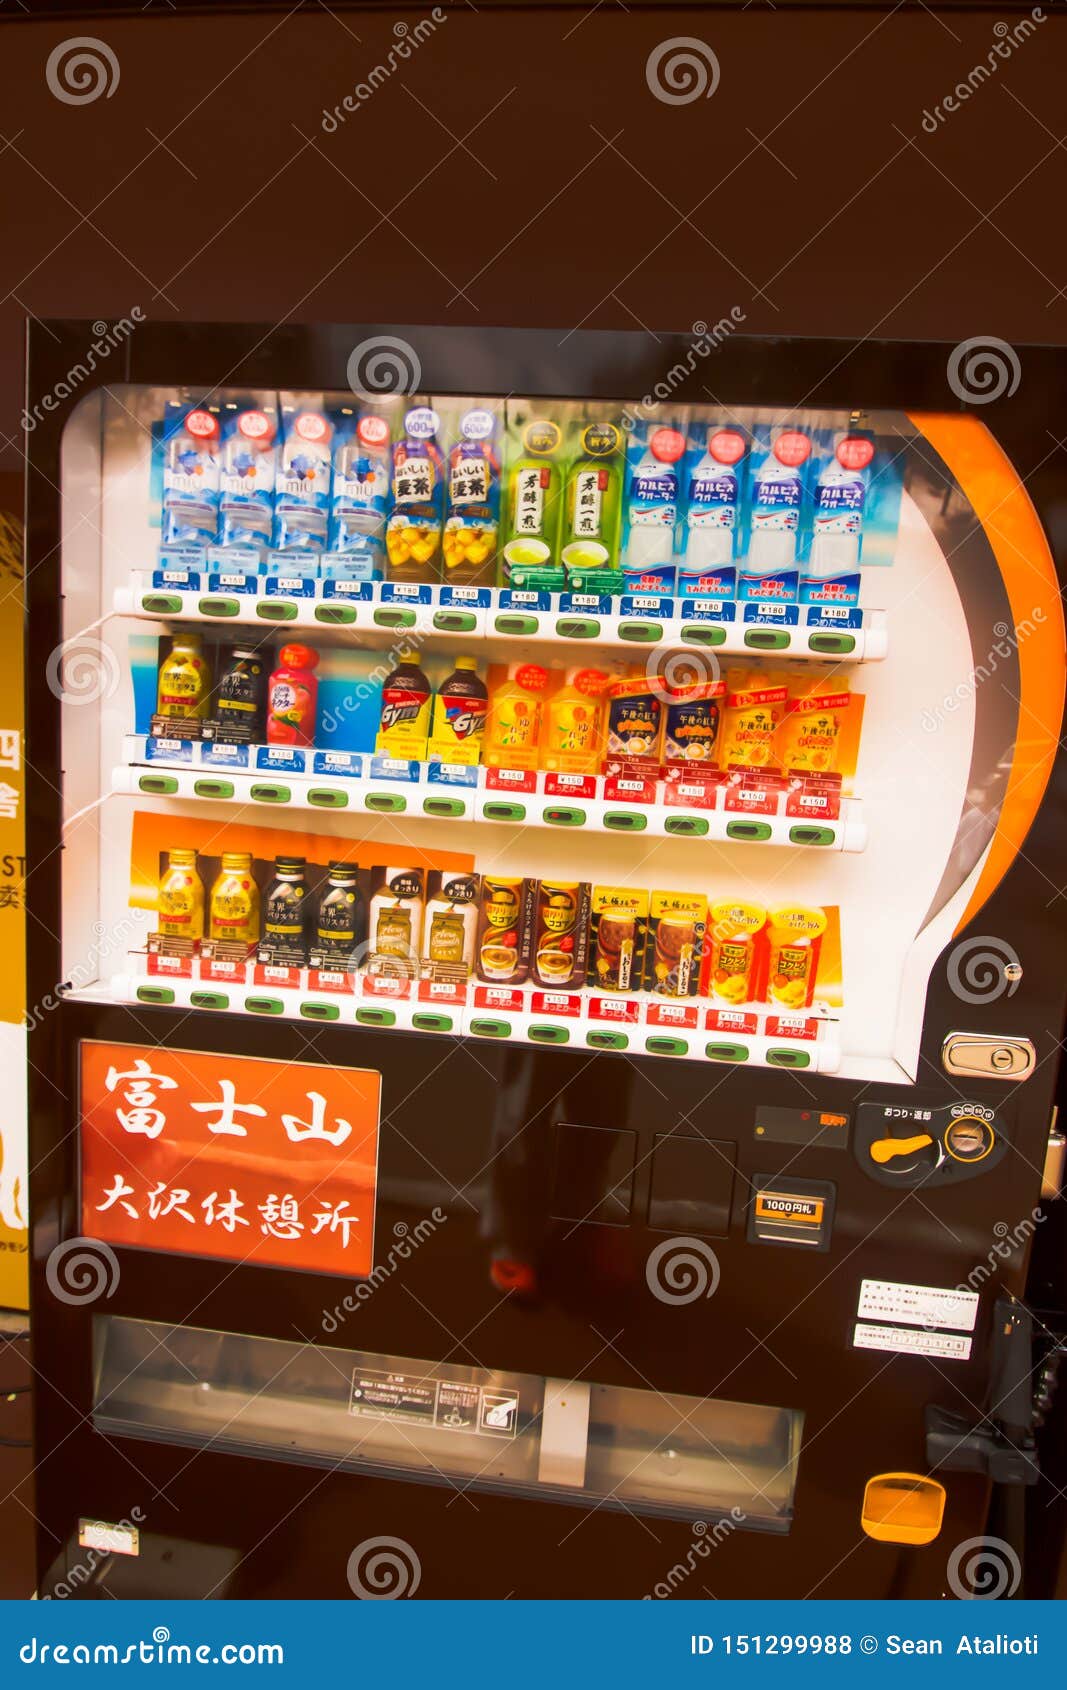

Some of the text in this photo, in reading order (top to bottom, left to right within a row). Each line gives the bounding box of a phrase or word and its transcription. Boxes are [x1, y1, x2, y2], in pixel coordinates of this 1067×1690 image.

[396, 464, 429, 477] おいしい
[452, 465, 484, 479] おいしい
[286, 480, 313, 492] miu
[345, 482, 373, 495] miu
[398, 477, 430, 497] 麦茶
[453, 478, 485, 498] 麦茶
[639, 480, 675, 492] カルピス
[695, 482, 734, 493] カルピス
[760, 485, 799, 496] カルピス
[522, 473, 539, 529] 芳醇一煎
[821, 489, 862, 500] カルピス
[580, 476, 597, 532] 芳醇一煎
[382, 704, 421, 727] Gym
[622, 709, 656, 720] 午後の紅茶
[680, 715, 715, 726] 午後の紅茶
[104, 1059, 352, 1146] 富士山
[884, 1107, 932, 1121] おつり・返却
[95, 1174, 360, 1249] 大沢休憩所
[766, 1199, 812, 1214] 1000円札
